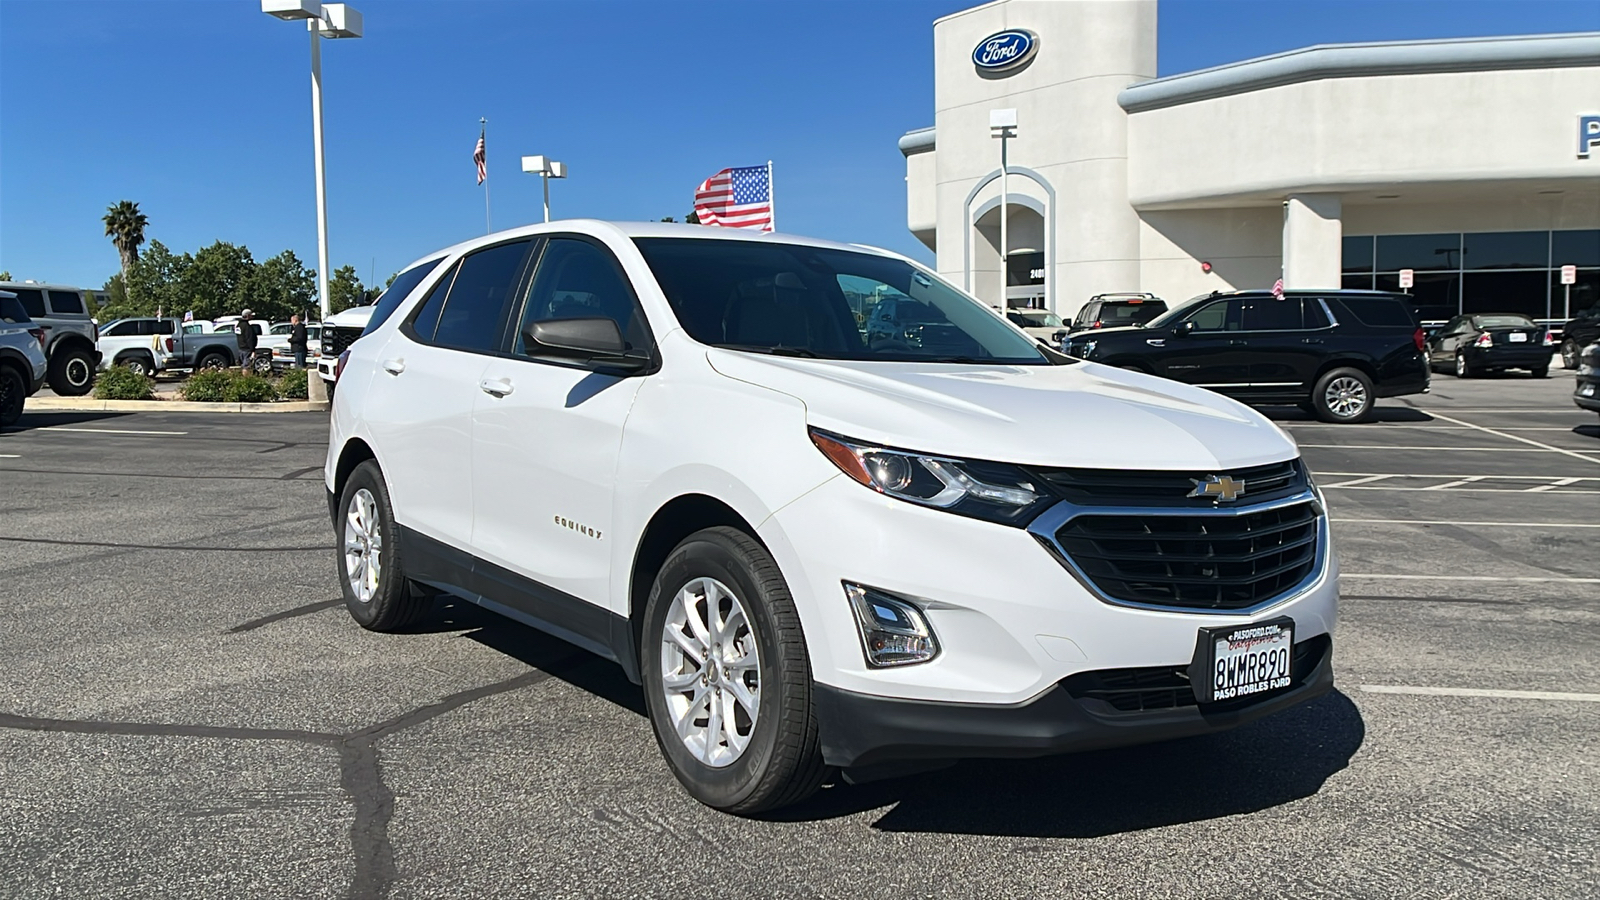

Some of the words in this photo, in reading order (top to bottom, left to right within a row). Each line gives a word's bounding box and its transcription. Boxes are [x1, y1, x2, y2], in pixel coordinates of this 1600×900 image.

[982, 36, 1019, 63] Ford
[554, 515, 602, 540] EQUINOX
[1233, 624, 1279, 641] PASOFORD.COM
[1215, 647, 1287, 689] 8WMR890
[1213, 687, 1236, 701] PASO
[1237, 681, 1269, 696] ROBLES
[1270, 676, 1291, 689] FORD
